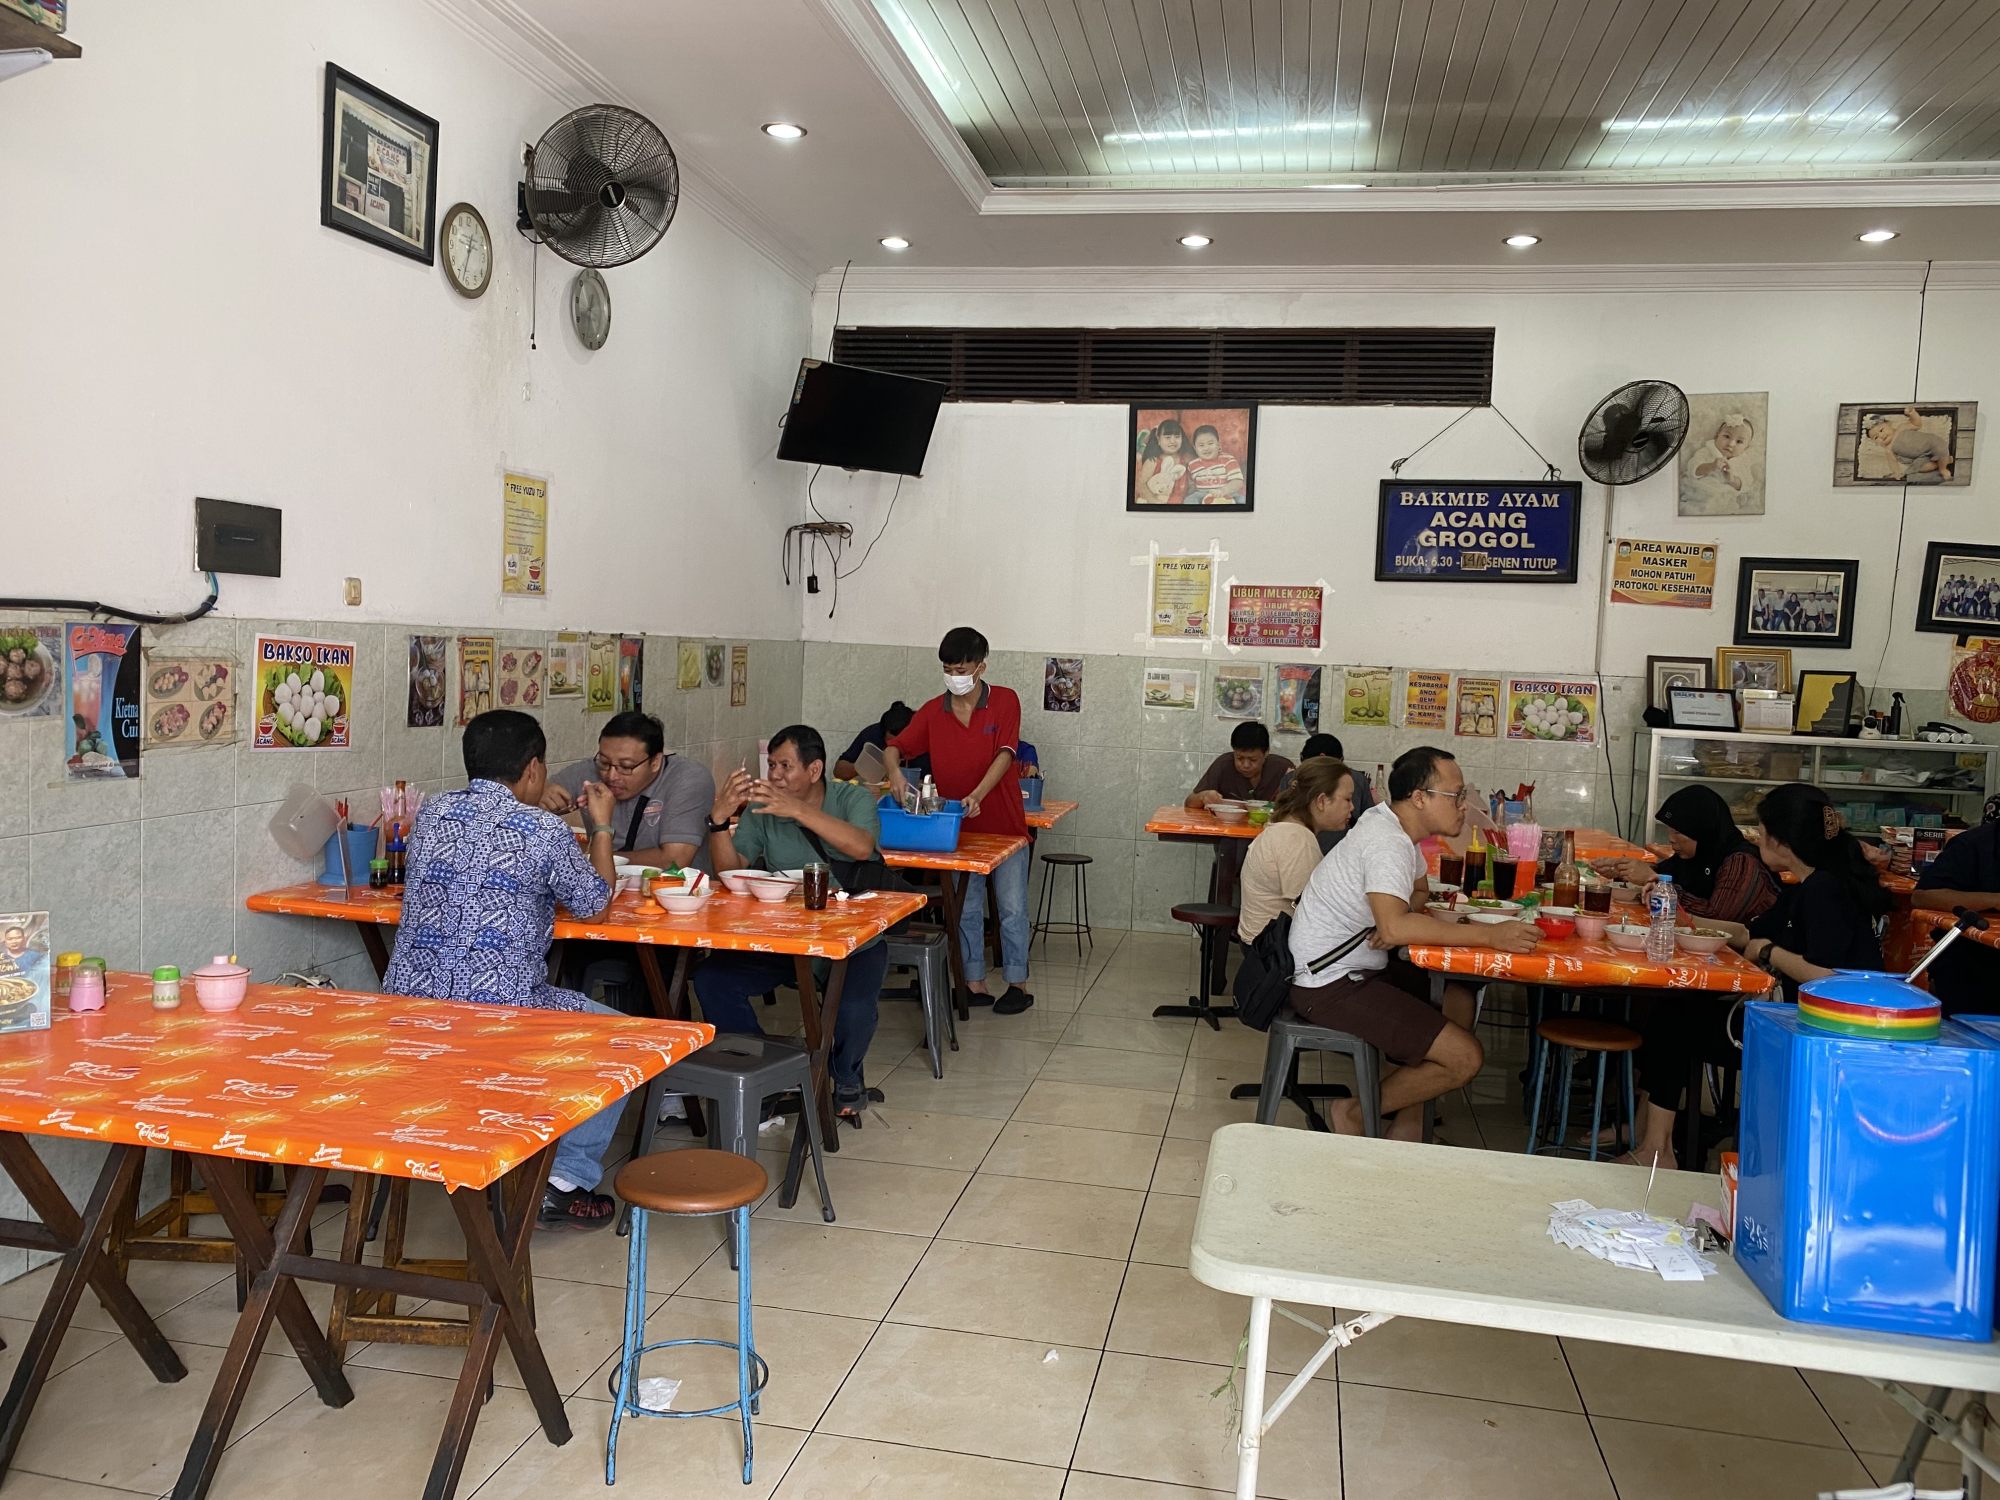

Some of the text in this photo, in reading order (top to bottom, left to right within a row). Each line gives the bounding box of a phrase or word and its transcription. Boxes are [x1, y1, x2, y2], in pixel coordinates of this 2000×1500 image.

[510, 483, 545, 498] FREE YUZU TEA
[1400, 491, 1560, 508] BAKMIE AYAM
[1430, 511, 1527, 529] ACANG
[1418, 531, 1535, 549] GROGOL
[1633, 543, 1700, 556] AREA WAJIB
[1395, 555, 1428, 567] BUKA:
[1431, 556, 1453, 567] 6.30
[1487, 557, 1557, 569] SENEN TUTUP
[1642, 557, 1688, 568] MASKER
[1630, 569, 1696, 581] MOHON PATUHI
[1614, 580, 1712, 594] PROTOKOL KESEHATAN
[1232, 588, 1320, 600] LIBUR IMLEK 2022
[263, 643, 350, 665] BAKSO IKAN
[1514, 683, 1593, 695] BAKSO IKAN
[122, 719, 139, 738] Cui
